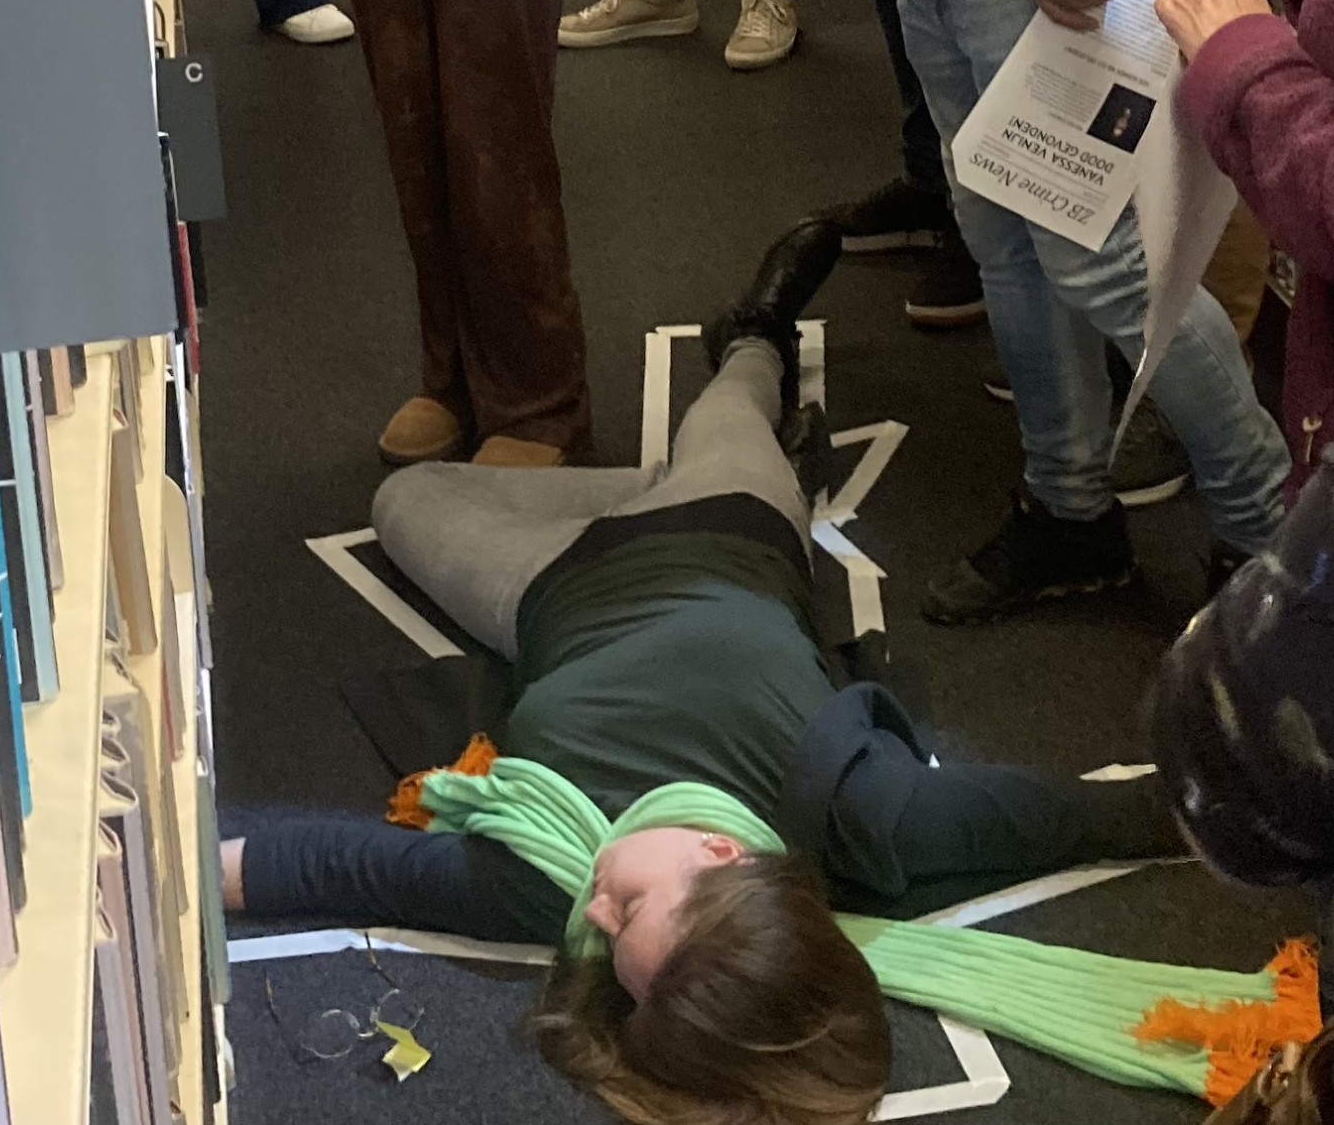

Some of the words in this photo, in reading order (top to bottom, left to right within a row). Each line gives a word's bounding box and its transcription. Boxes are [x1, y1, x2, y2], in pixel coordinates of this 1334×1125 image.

[184, 62, 203, 83] C
[1002, 128, 1047, 159] VENIJN
[1007, 115, 1079, 157] GEVONDEN!
[969, 153, 1019, 187] News
[1052, 153, 1105, 186] VANESSA
[1079, 151, 1115, 175] DOOD
[1017, 179, 1069, 213] Crime
[1067, 204, 1095, 225] ZB
